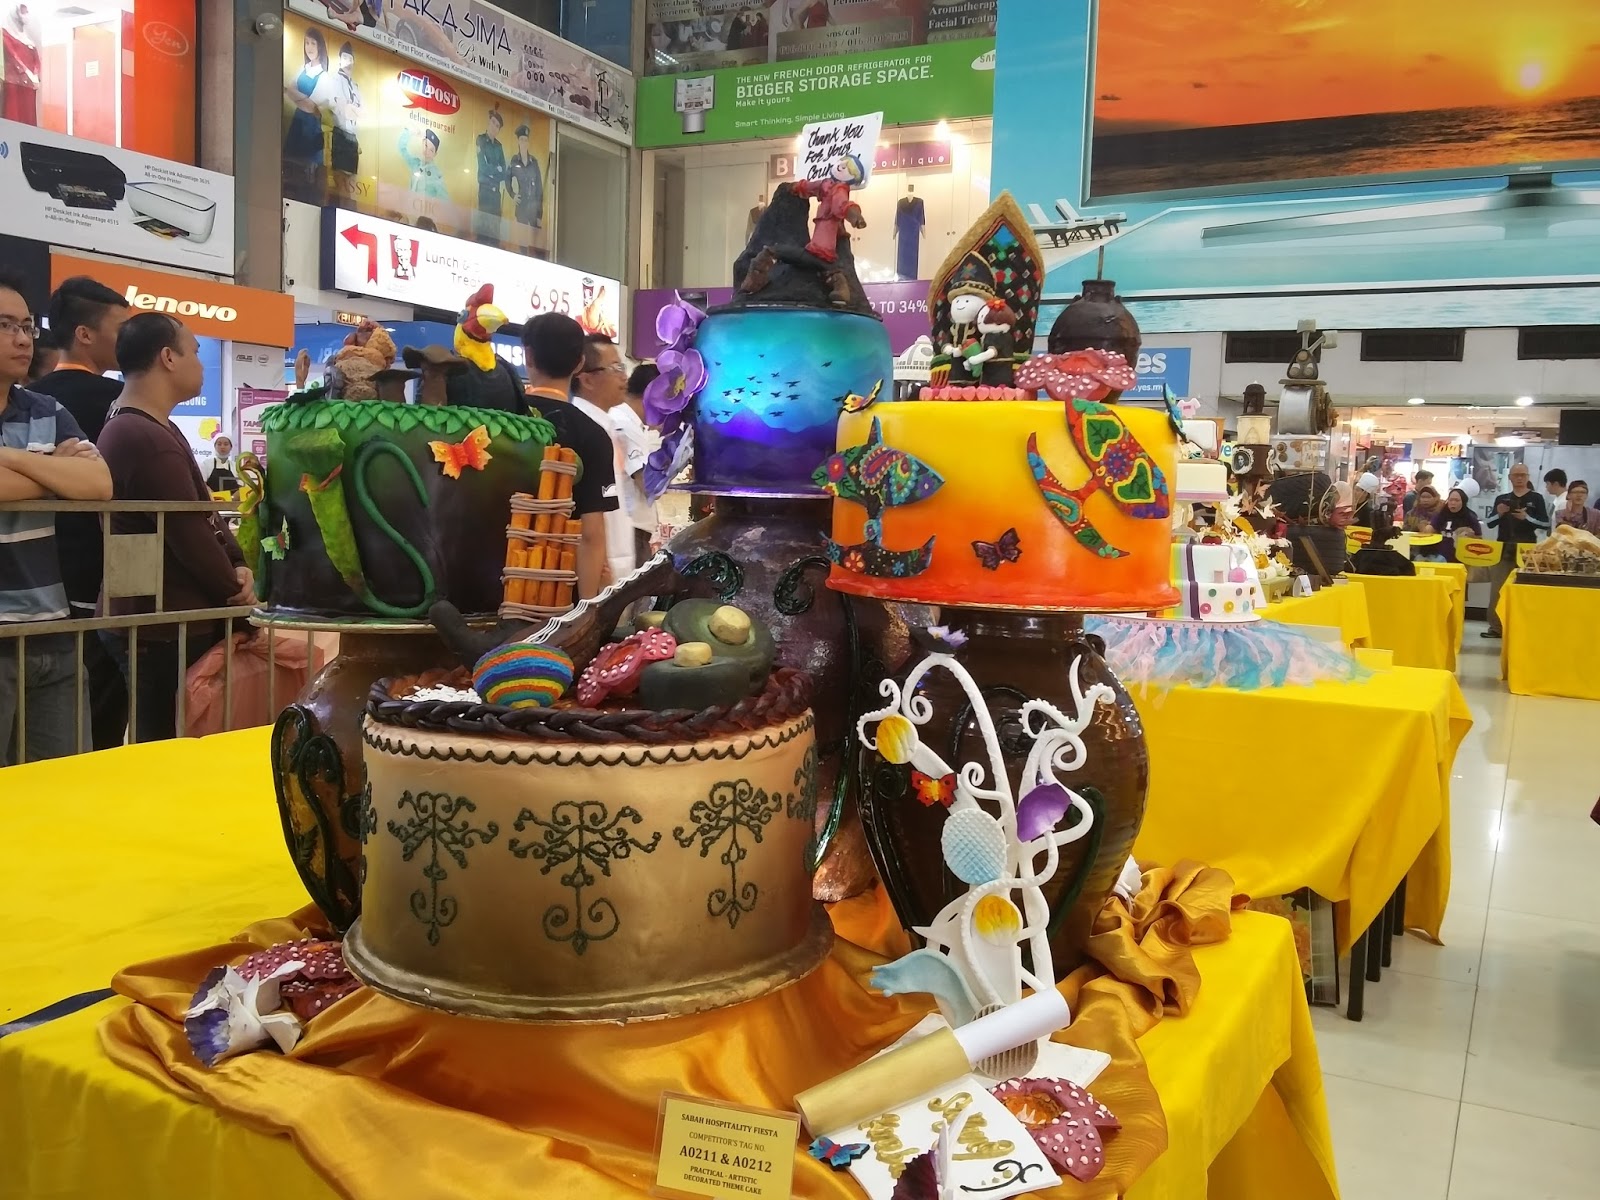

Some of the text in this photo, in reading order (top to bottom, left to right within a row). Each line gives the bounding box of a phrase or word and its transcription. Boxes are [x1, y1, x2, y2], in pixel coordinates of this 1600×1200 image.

[928, 13, 997, 30] Facial Treatm
[398, 42, 410, 54] First
[736, 55, 932, 84] THE NEW FRENCH DOOR REFRIGERATOR FOR
[736, 65, 934, 99] BIGGER STORAGE SPACE.
[735, 99, 757, 108] Make
[766, 97, 792, 107] yours.
[735, 119, 759, 128] Smart
[795, 113, 820, 124] Simple
[822, 111, 847, 121] Living.
[808, 124, 864, 148] Thank You
[167, 177, 182, 185] Printer
[177, 172, 199, 183] Advantage
[76, 219, 92, 228] Printer
[81, 213, 106, 224] Advantage
[425, 251, 459, 269] Lunch
[124, 285, 237, 322] lenovo
[880, 301, 895, 314] TO
[899, 300, 928, 313] 34%
[1135, 353, 1167, 374] es
[1130, 384, 1164, 392] .yes.my
[178, 396, 207, 406] SUNG
[199, 448, 212, 458] edge
[681, 1113, 778, 1138] SABAH HOSPITALITY FIESTA
[689, 1131, 766, 1152] COMPETITOR'S TAG NO.
[679, 1145, 772, 1173] A0211 & A0212
[690, 1165, 724, 1178] PRACTICAL
[728, 1173, 758, 1185] ARTISTIC
[683, 1173, 762, 1195] DECORATED THEME CAKE
